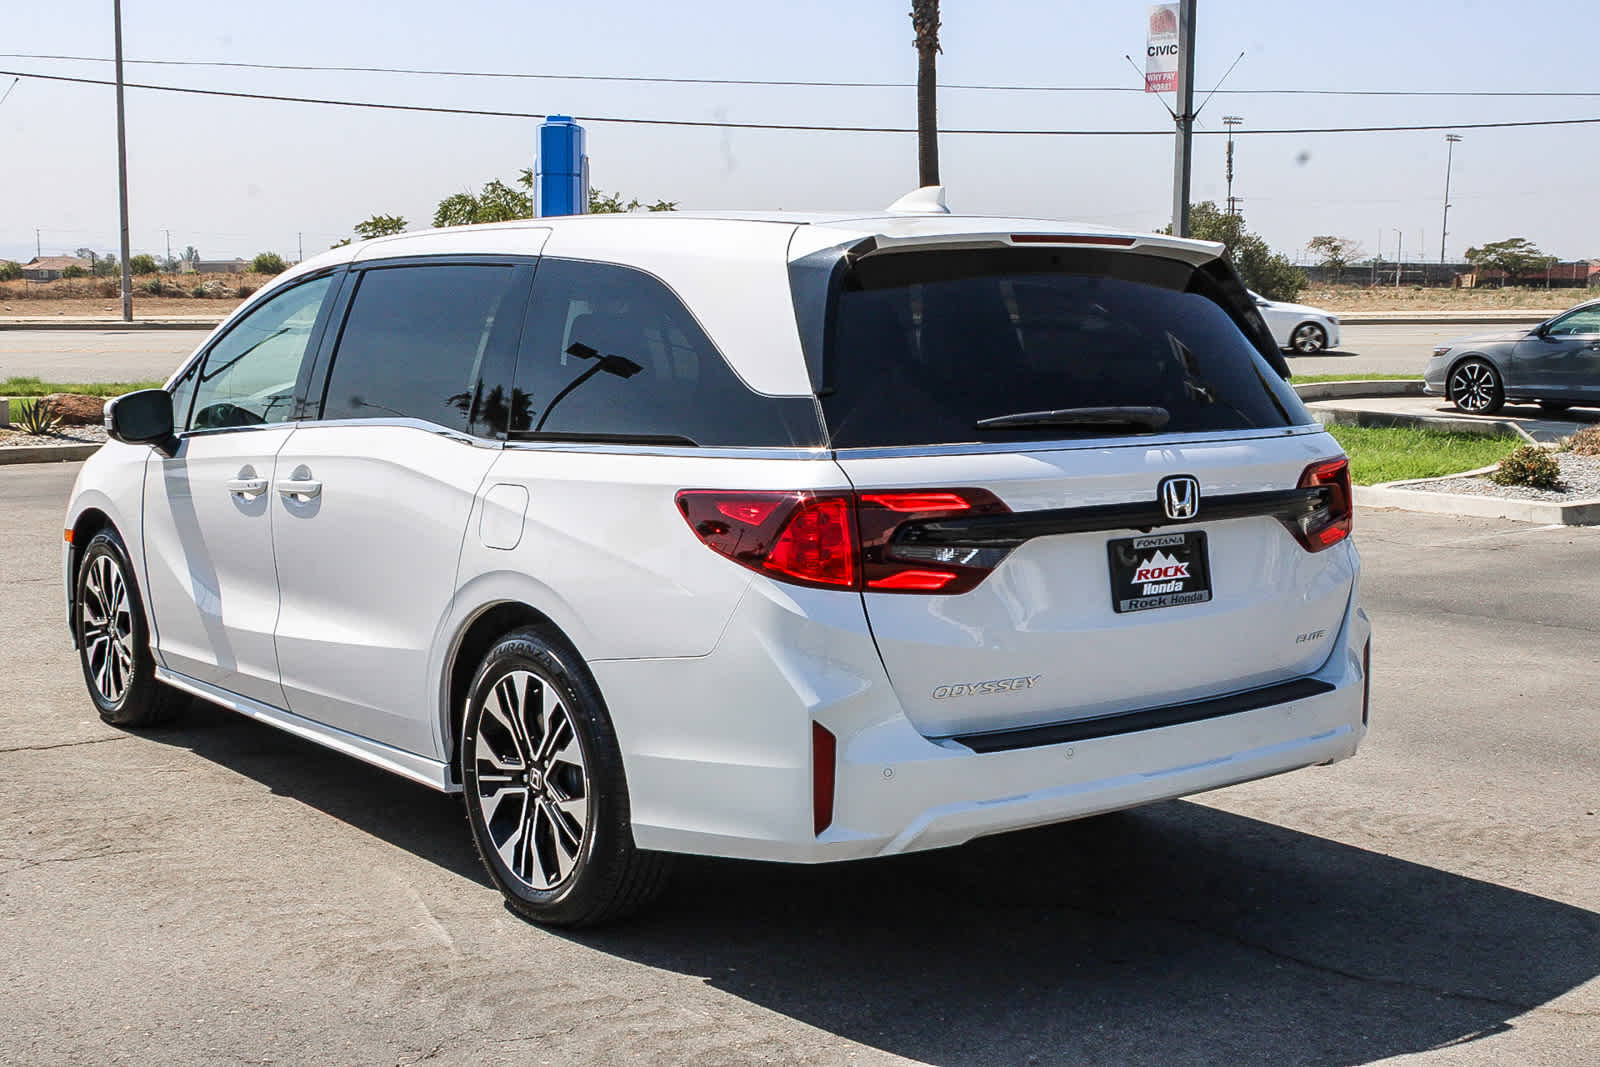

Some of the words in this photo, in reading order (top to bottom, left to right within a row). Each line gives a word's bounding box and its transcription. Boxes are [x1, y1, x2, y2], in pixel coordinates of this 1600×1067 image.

[1147, 44, 1178, 57] CIVIC
[1147, 73, 1162, 81] WHY
[1163, 72, 1176, 81] PAY
[1136, 536, 1184, 547] FONTANA
[1137, 565, 1187, 580] ROCK
[1143, 580, 1184, 596] Honda
[1129, 597, 1167, 609] Rock
[1171, 592, 1203, 604] Honda
[1296, 630, 1329, 643] ELITE
[932, 673, 1041, 699] ODYSSEY
